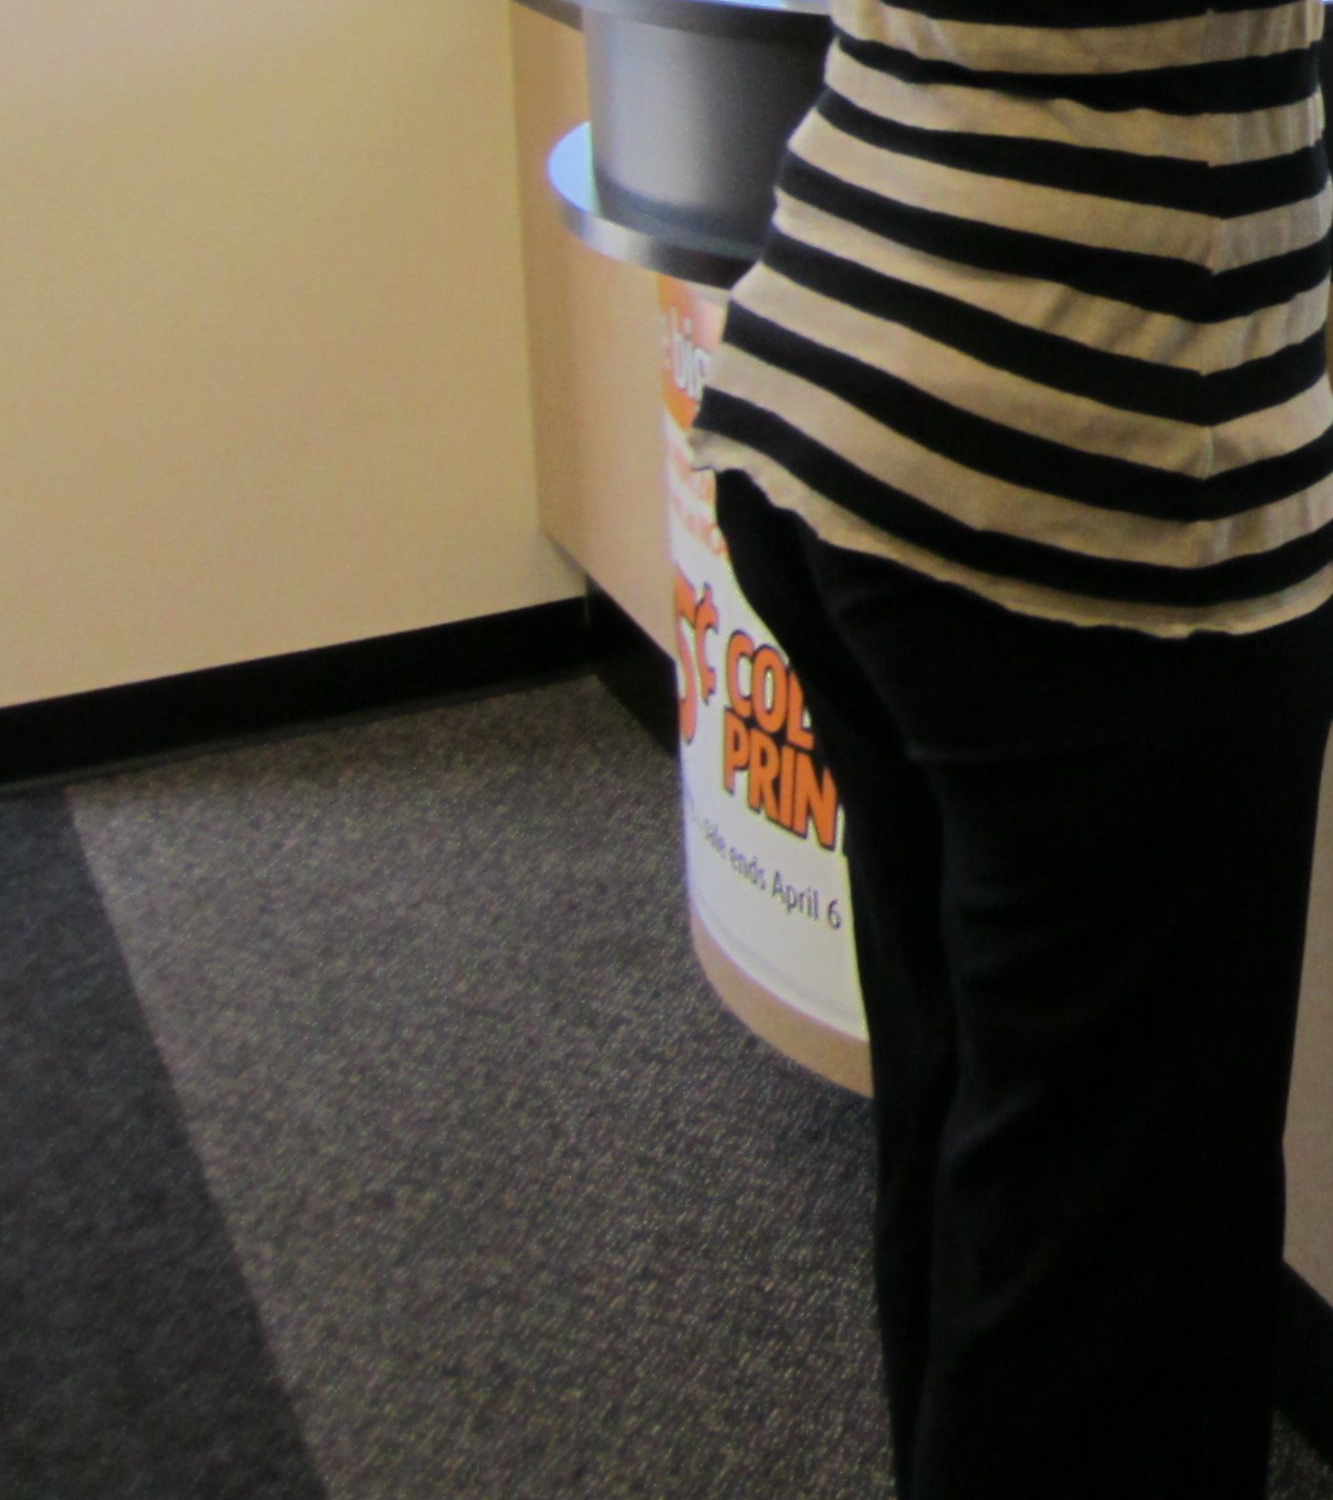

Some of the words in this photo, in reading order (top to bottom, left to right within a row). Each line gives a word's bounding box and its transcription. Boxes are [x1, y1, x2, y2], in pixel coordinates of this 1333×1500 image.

[724, 705, 837, 851] PRIN
[730, 847, 766, 890] ends
[773, 871, 818, 921] April
[828, 898, 842, 930] 6
